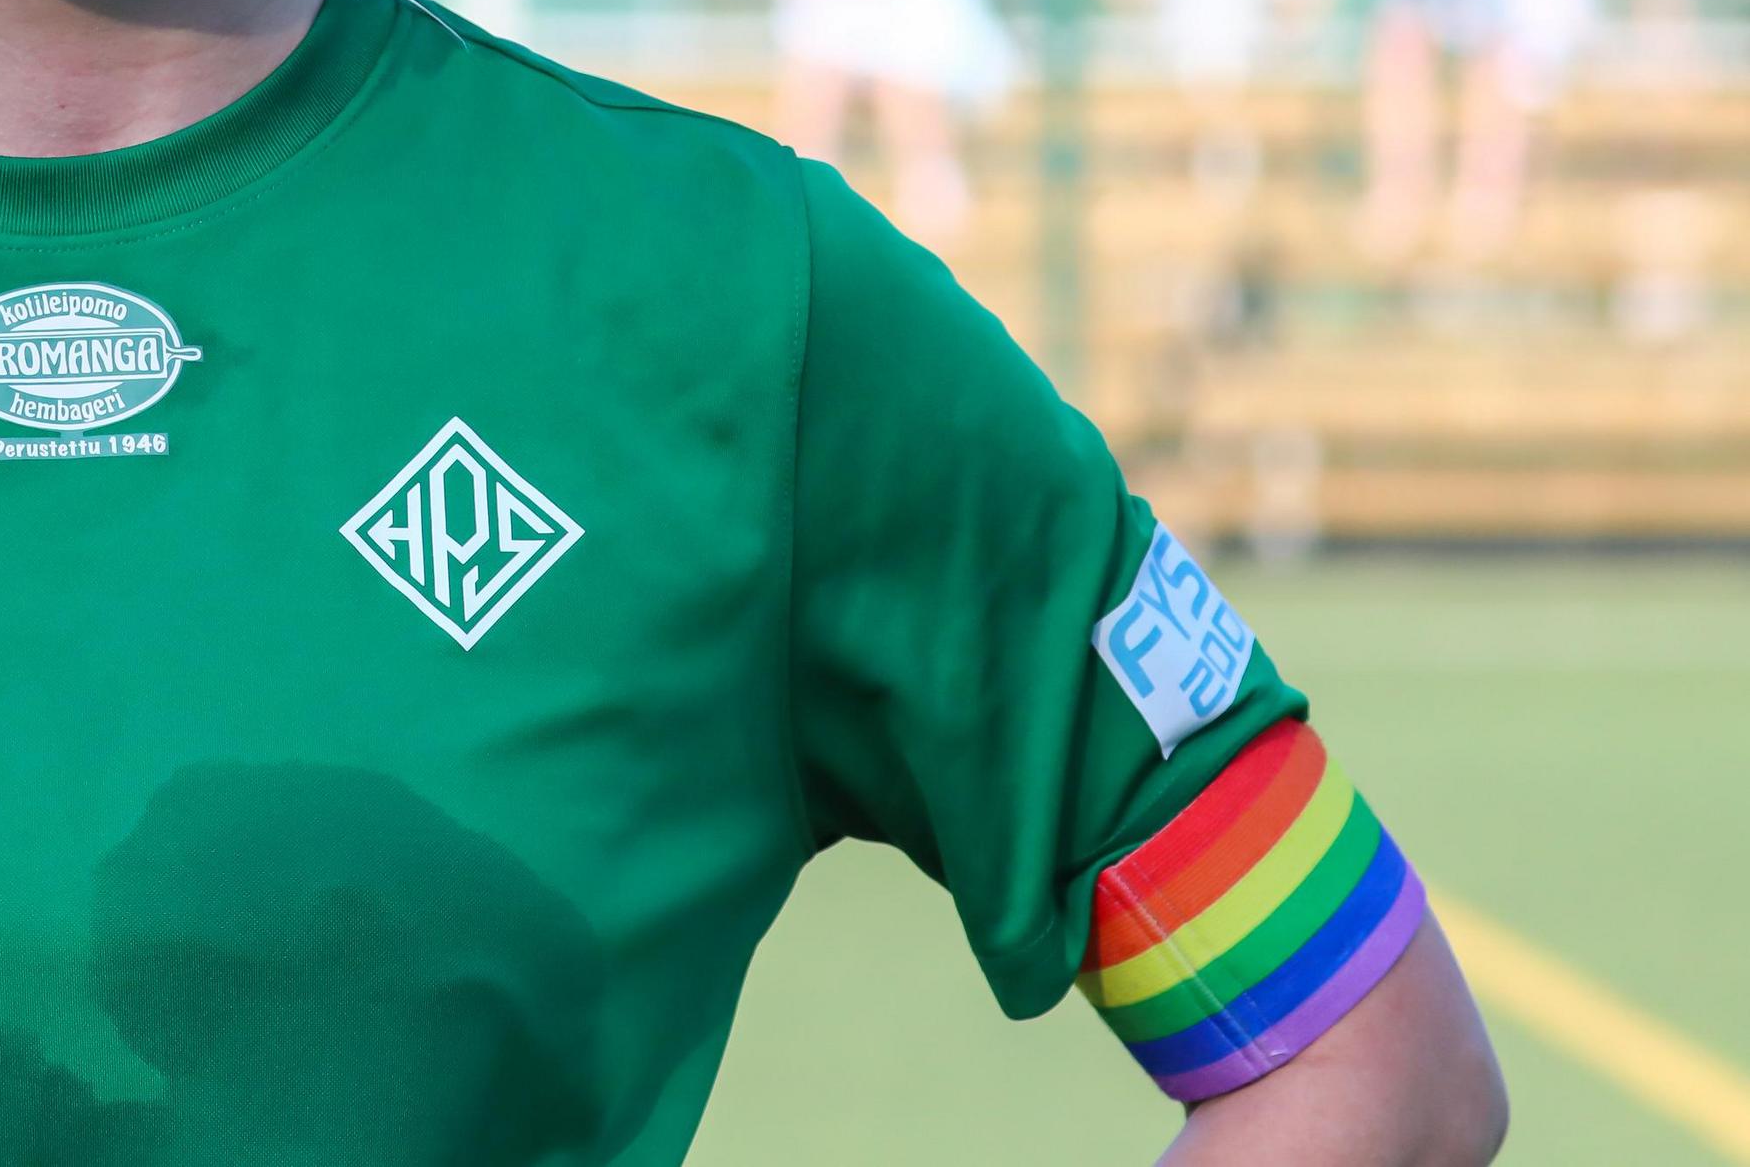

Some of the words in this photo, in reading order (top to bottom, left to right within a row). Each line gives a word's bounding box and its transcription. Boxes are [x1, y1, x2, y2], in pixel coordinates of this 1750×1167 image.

[9, 389, 126, 423] hembageri
[108, 434, 167, 454] 1946
[367, 443, 555, 622] HPS
